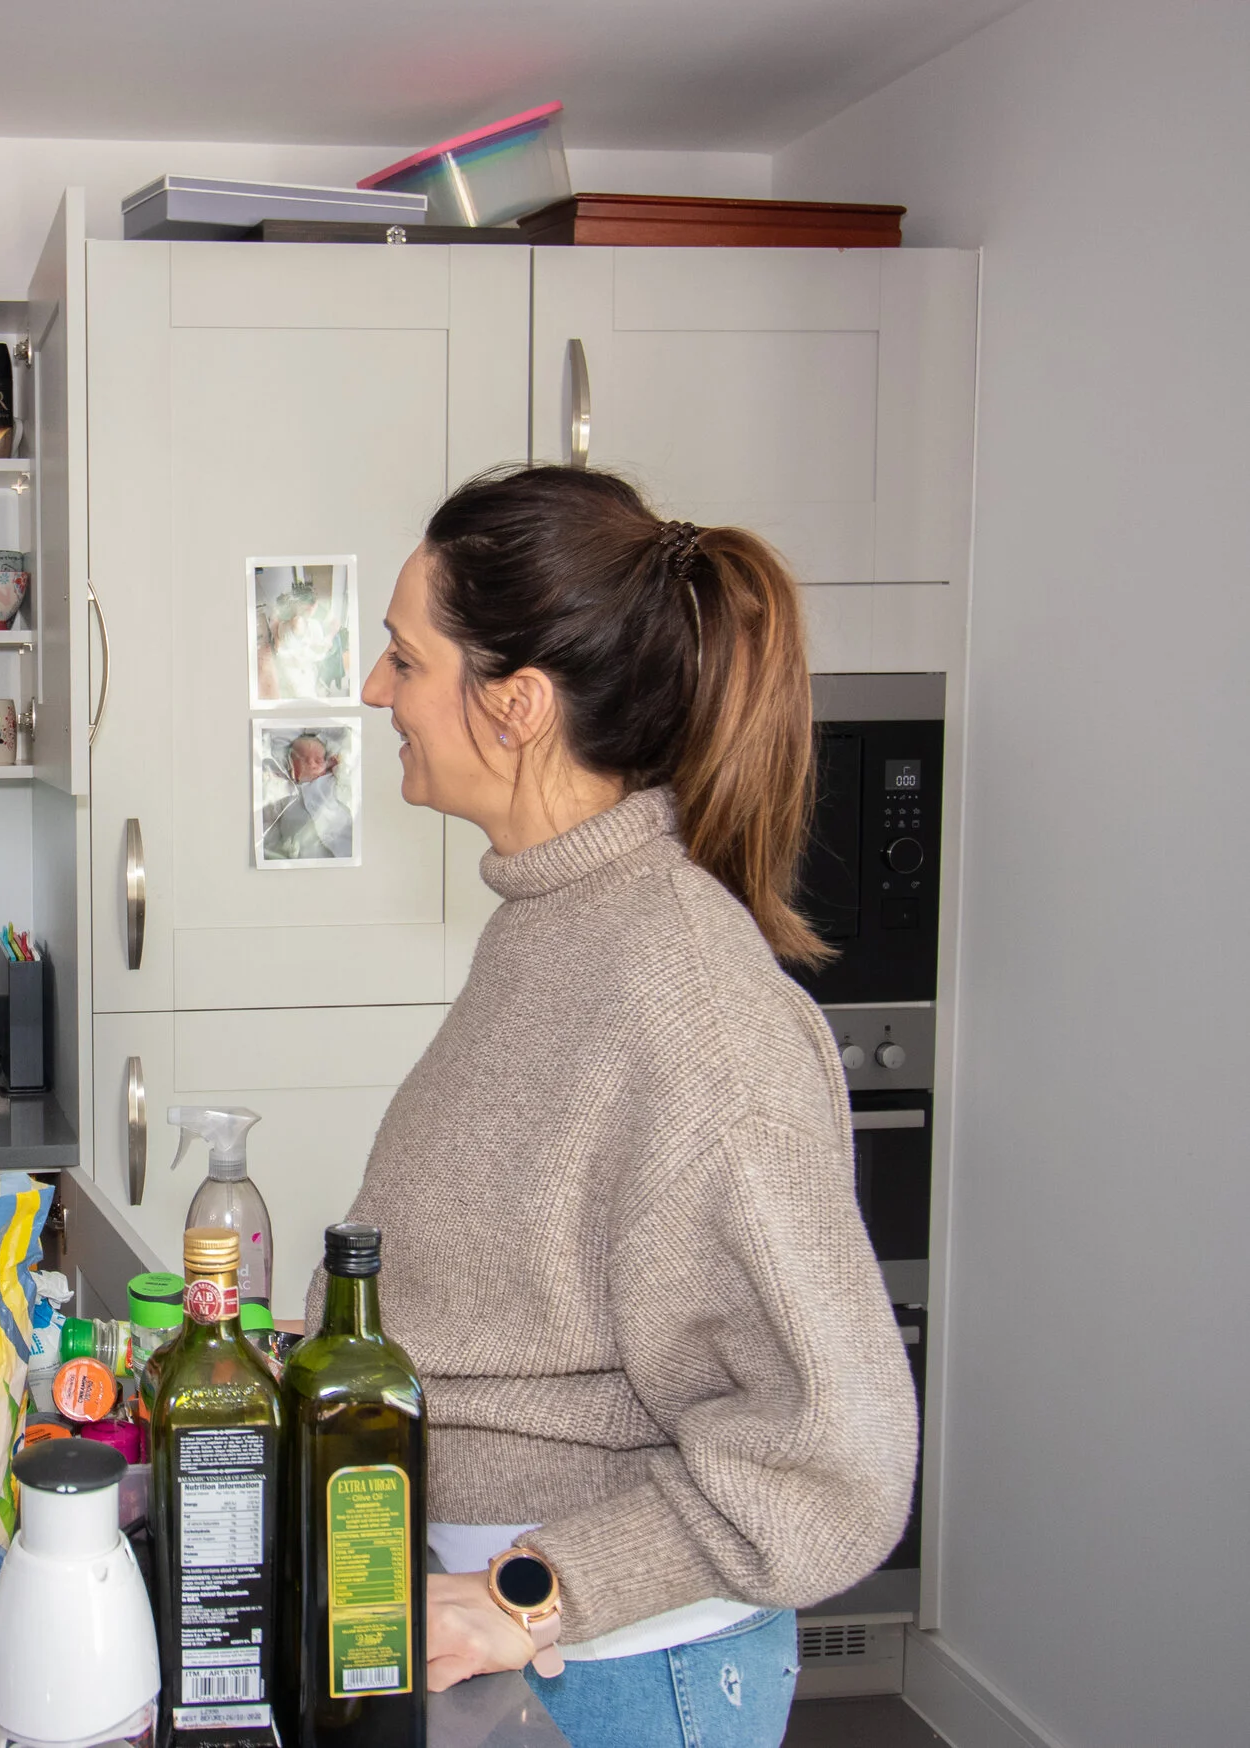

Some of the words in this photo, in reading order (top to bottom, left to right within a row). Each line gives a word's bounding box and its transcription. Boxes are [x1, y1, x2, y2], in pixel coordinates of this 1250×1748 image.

[78, 1376, 86, 1403] CINNAMON
[338, 1480, 366, 1494] EXTRA
[368, 1476, 397, 1491] VIRGIN
[372, 1492, 383, 1500] Oil
